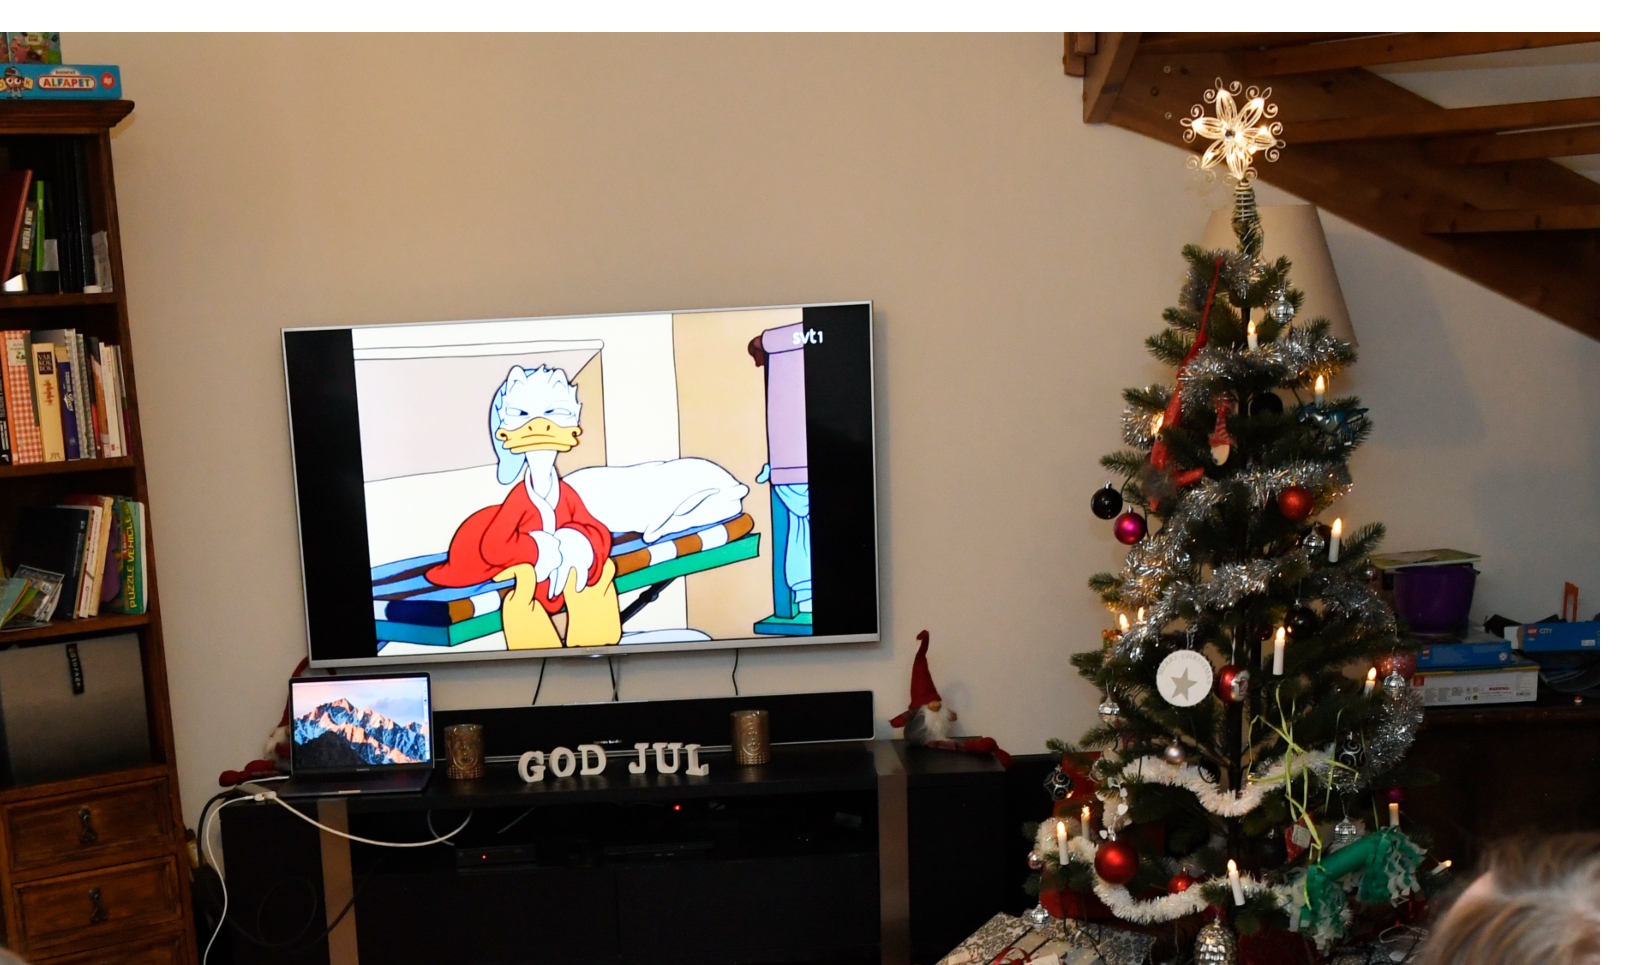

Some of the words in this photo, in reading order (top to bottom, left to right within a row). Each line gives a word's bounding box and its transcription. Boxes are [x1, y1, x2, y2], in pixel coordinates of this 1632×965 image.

[43, 78, 90, 88] ALFAPET
[792, 328, 824, 345] svt1
[125, 516, 135, 563] VEHICLE
[126, 565, 138, 609] PUZZLE
[1539, 627, 1553, 635] CITY
[518, 744, 607, 783] GOD
[628, 742, 709, 776] JUL
